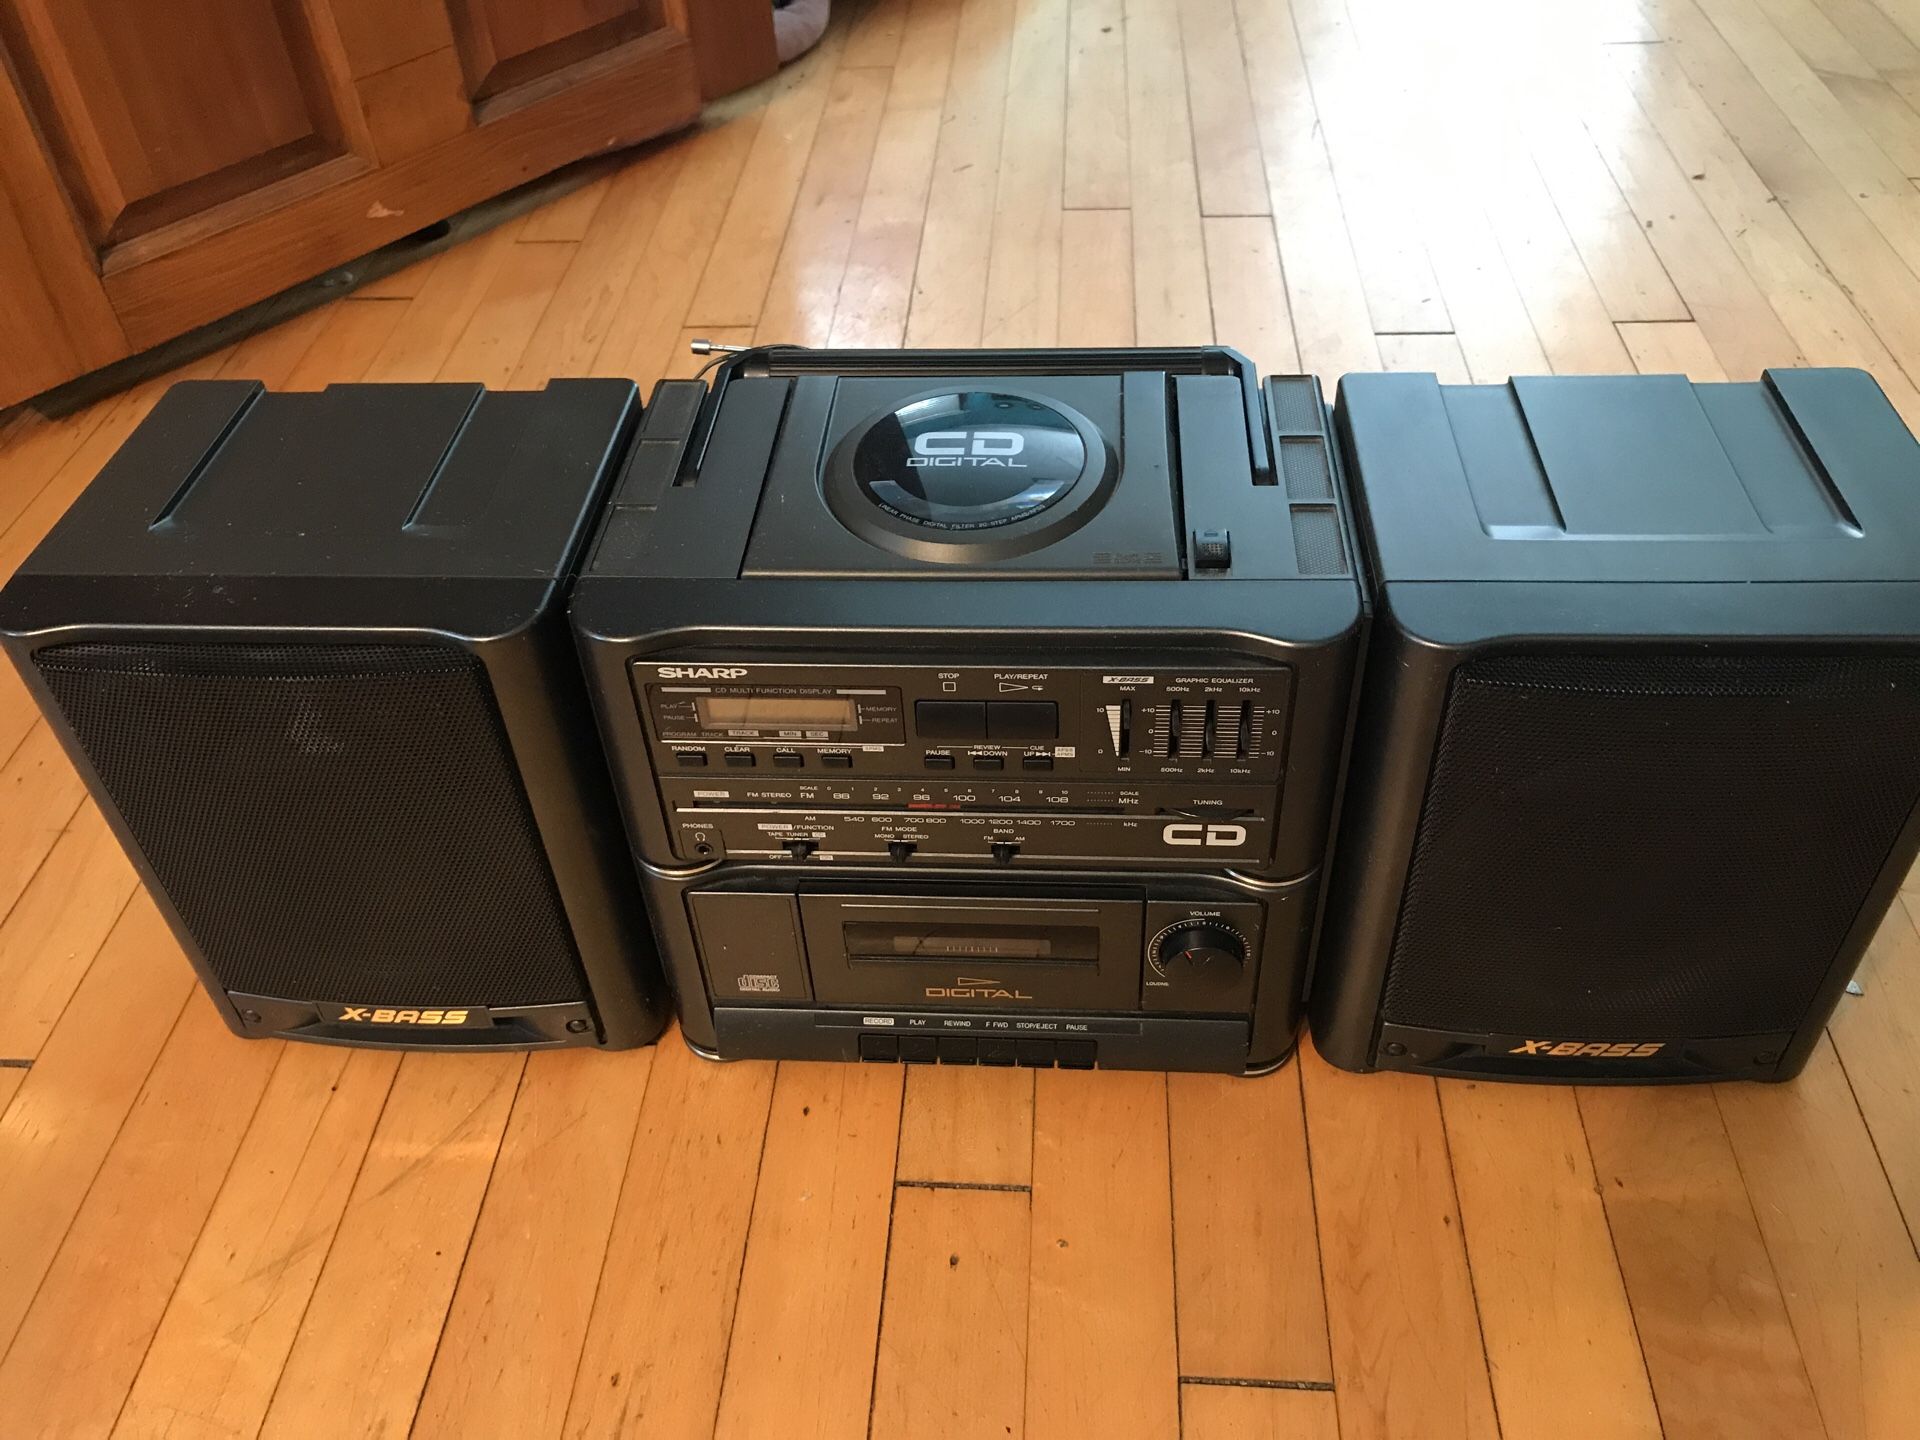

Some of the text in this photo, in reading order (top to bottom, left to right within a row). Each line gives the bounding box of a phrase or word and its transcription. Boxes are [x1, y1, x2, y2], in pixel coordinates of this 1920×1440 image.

[914, 431, 1025, 456] CD
[906, 457, 1027, 468] DIGITAL
[900, 513, 920, 523] PHASE
[924, 520, 948, 528] DIGITAL
[657, 668, 748, 679] SHARP
[1118, 797, 1139, 805] MHz
[1162, 824, 1246, 846] CD
[926, 987, 1032, 999] DIGITAL
[338, 1006, 469, 1024] X-BASS
[1016, 1022, 1058, 1030] STOP/EJECT
[1508, 1040, 1666, 1057] X-BASS
